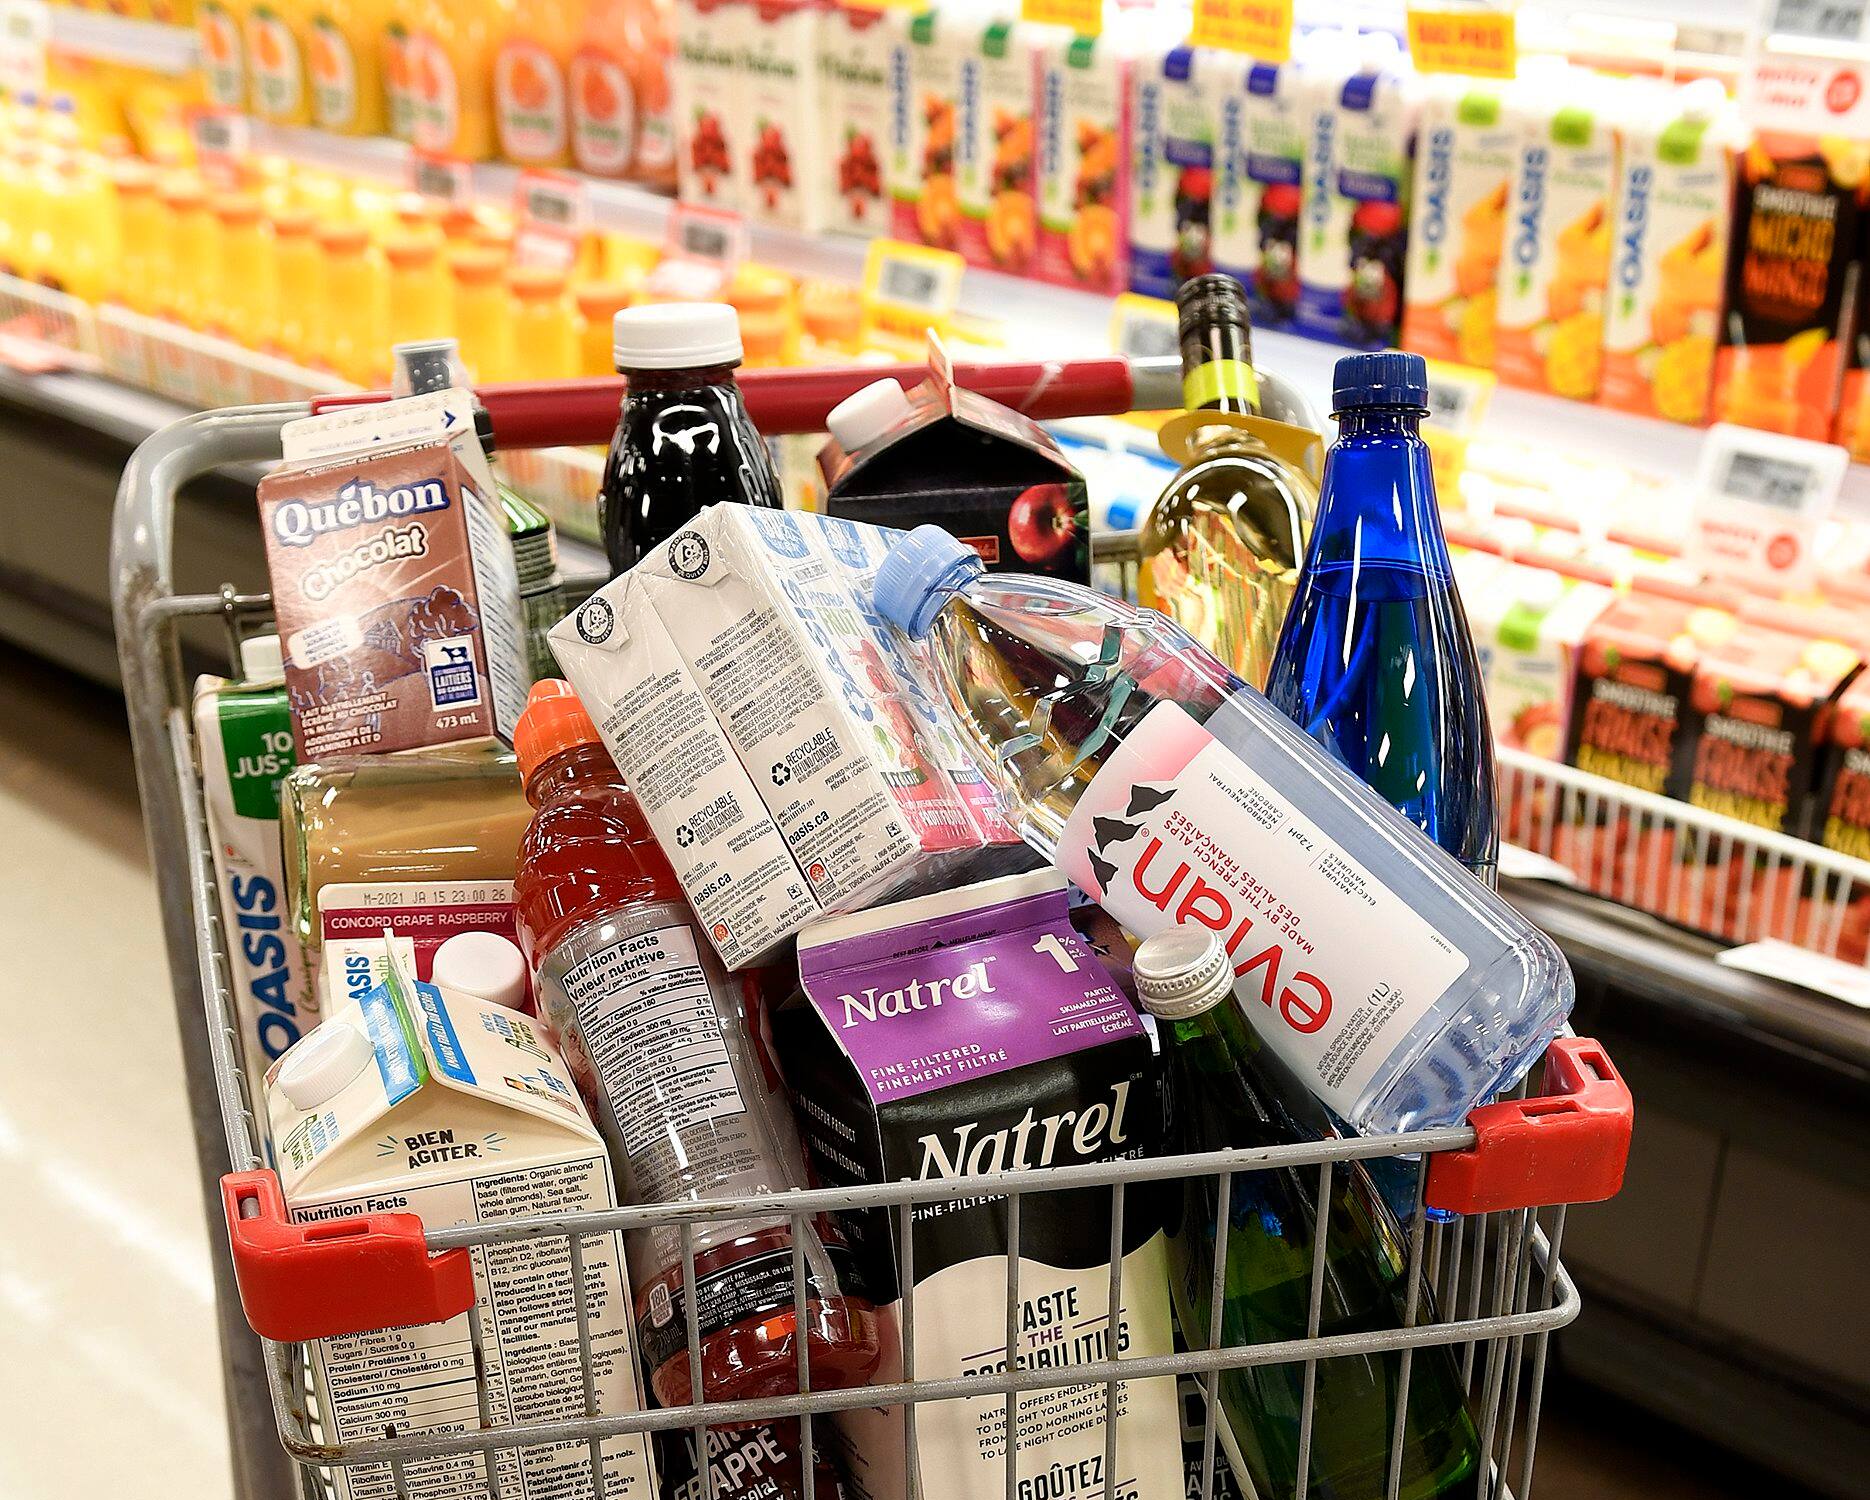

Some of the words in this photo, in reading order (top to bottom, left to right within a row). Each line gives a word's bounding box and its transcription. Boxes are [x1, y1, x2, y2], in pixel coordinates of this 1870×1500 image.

[1422, 128, 1453, 245] OASIS
[1513, 147, 1548, 264] OASIS
[1620, 165, 1653, 288] OASIS
[275, 482, 446, 545] Québon
[303, 525, 427, 600] Chocolat
[435, 714, 459, 728] 473
[460, 712, 480, 726] mL
[261, 732, 294, 753] 10
[785, 727, 835, 766] RECYCLABLE
[688, 790, 736, 828] RECYCLABLE
[788, 810, 830, 846] oasis.ca
[1163, 819, 1194, 846] ALPS
[1170, 810, 1240, 872] FRANÇAISES
[1287, 827, 1314, 852] 7.2pH
[1192, 848, 1238, 888] FRENCH
[433, 891, 445, 903] 15
[452, 890, 485, 902] 23:00
[492, 889, 506, 901] 26
[693, 872, 732, 906] oasis.ca
[1240, 871, 1277, 904] ALPES
[331, 916, 391, 929] CONCORD
[394, 914, 434, 927] GRAPE
[439, 912, 507, 925] RASPBERRY
[1262, 907, 1279, 924] BY
[1276, 904, 1301, 926] DES
[1132, 835, 1334, 1035] evian
[1280, 924, 1315, 955] MADE
[229, 873, 302, 1061] OASIS
[564, 951, 617, 989] Nutrition
[619, 934, 659, 957] Facts
[570, 974, 606, 1001] Valeur
[609, 950, 666, 978] nutritive
[836, 961, 997, 1029] Natrel
[1031, 933, 1079, 974] 1%
[1059, 999, 1098, 1014] SKIMMED
[1098, 994, 1119, 1007] MILK
[1084, 986, 1113, 999] PARTLY
[1367, 982, 1391, 1007] (1L)
[1071, 1009, 1129, 1031] PARTIELLEMENT
[1102, 1017, 1134, 1034] ÉCRÉMÉ
[870, 1043, 982, 1079] FINE-FILTERED
[876, 1064, 953, 1093] FINEMENT
[957, 1049, 1008, 1072] FILTRÉ
[404, 1129, 454, 1152] BIEN
[917, 1081, 1130, 1181] Natrel
[408, 1143, 483, 1169] AGITER.
[476, 1174, 528, 1189] Ingredients:
[529, 1168, 562, 1180] Organic
[564, 1162, 593, 1173] almond
[478, 1190, 498, 1199] base
[558, 1173, 588, 1185] organic
[297, 1204, 363, 1223] Nutrition
[366, 1196, 408, 1212] Facts
[479, 1200, 503, 1209] whole
[547, 1189, 564, 1197] Sea
[493, 1281, 510, 1290] May
[513, 1274, 544, 1286] contain
[546, 1270, 569, 1279] other
[500, 1311, 554, 1326] management
[1017, 1286, 1080, 1334] ASTE
[1028, 1326, 1064, 1348] THE
[328, 1364, 362, 1374] Protein
[368, 1353, 410, 1367] Protéines
[331, 1373, 383, 1386] Cholesterol
[390, 1363, 441, 1376] Cholestérol
[334, 1387, 369, 1399] Sodium
[1020, 1393, 1055, 1410] OFFERS
[1041, 1404, 1068, 1417] YOUR
[1071, 1393, 1100, 1407] TASTE
[336, 1400, 380, 1413] Potassium
[1046, 1408, 1093, 1428] MORNING
[339, 1414, 373, 1426] Calcium
[1024, 1432, 1055, 1448] NIGHT
[1058, 1421, 1094, 1437] COOKIE
